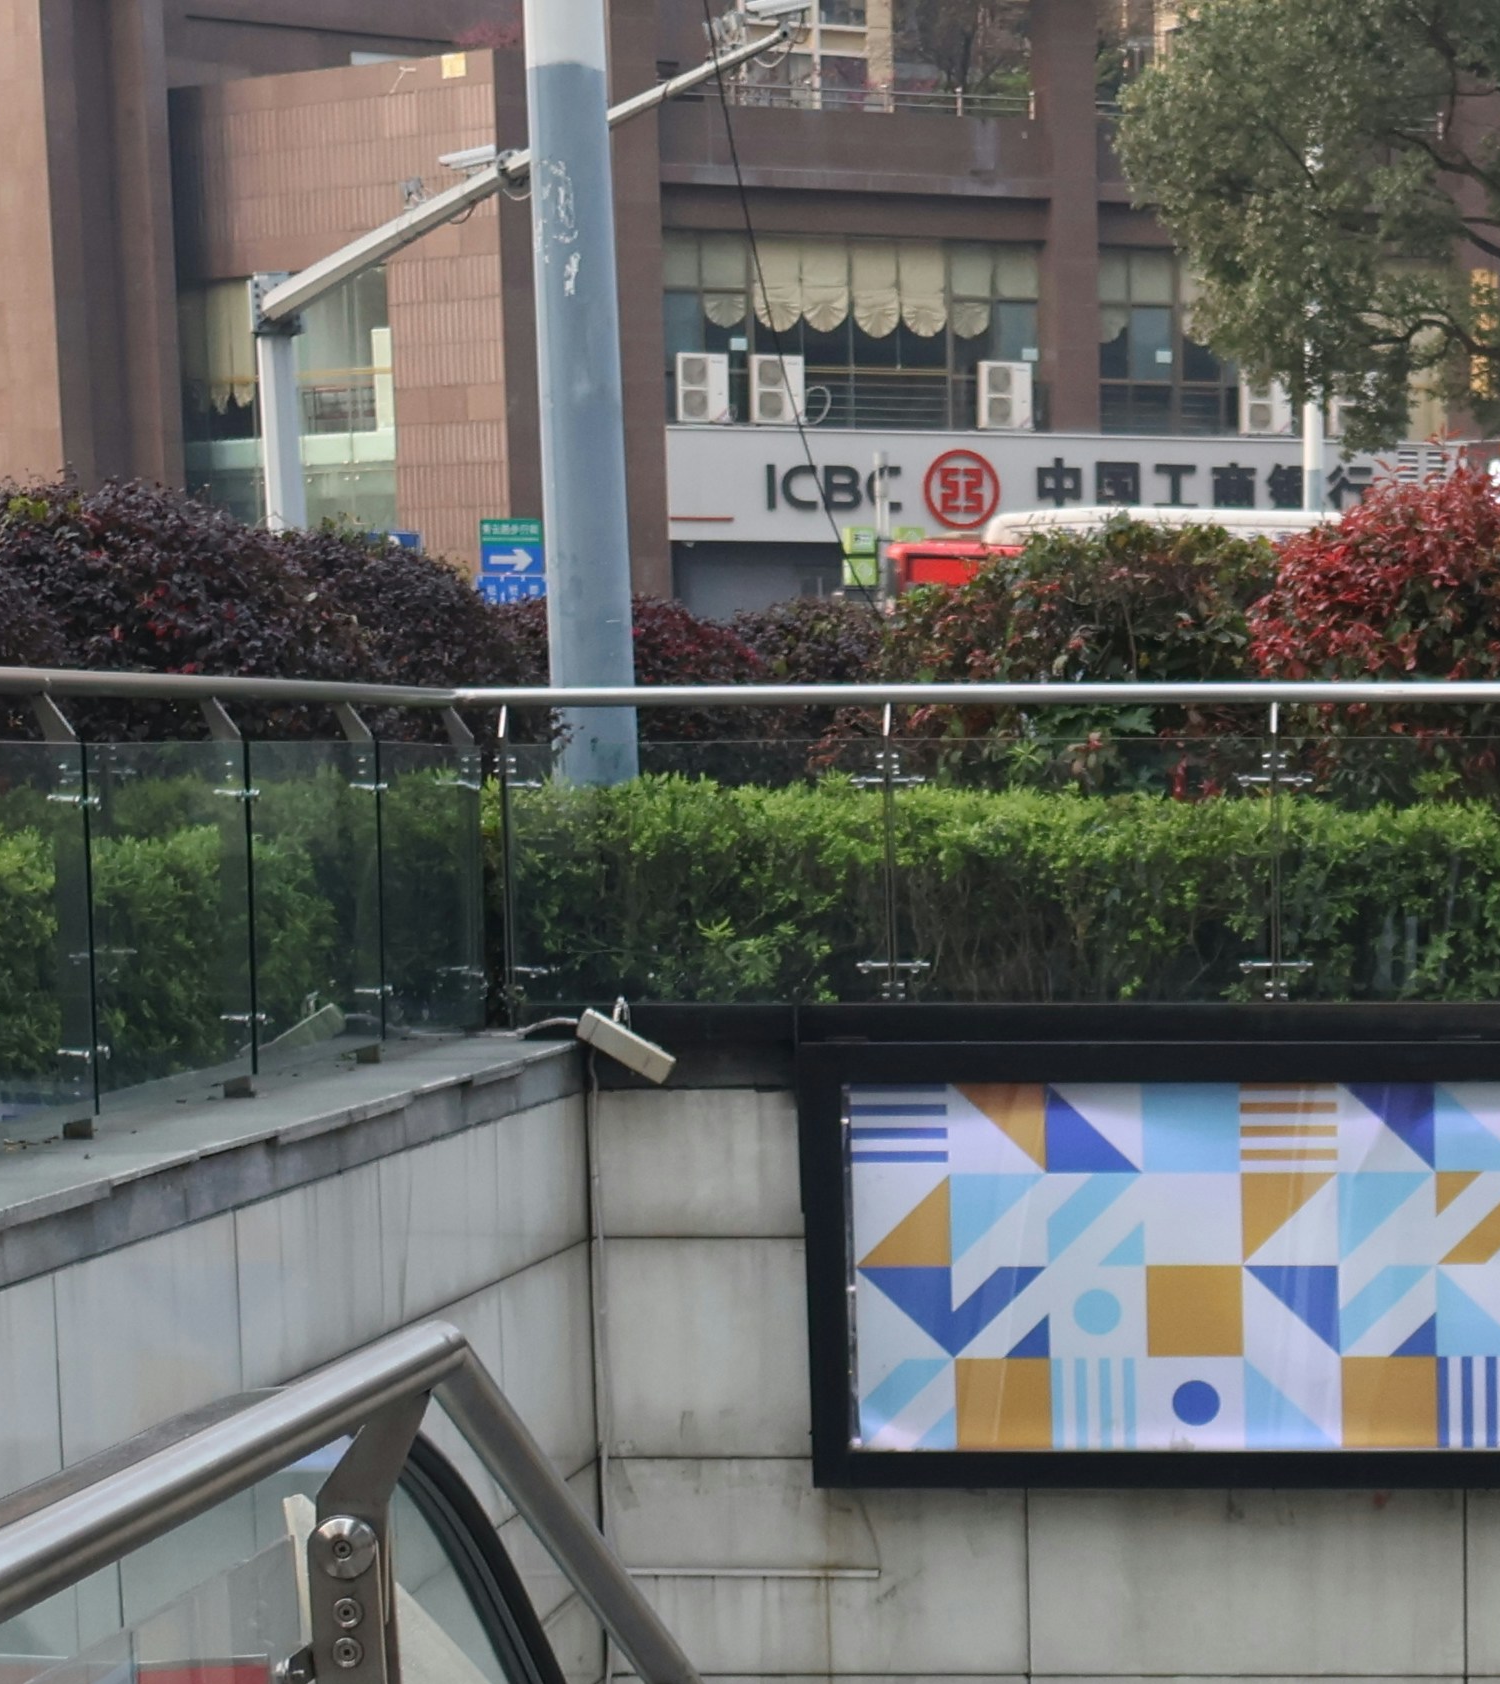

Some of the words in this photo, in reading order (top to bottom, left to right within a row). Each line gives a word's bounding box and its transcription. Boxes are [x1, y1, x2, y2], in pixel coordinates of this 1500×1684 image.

[765, 463, 903, 512] ICBC
[1036, 457, 1375, 510] 中国工商银行
